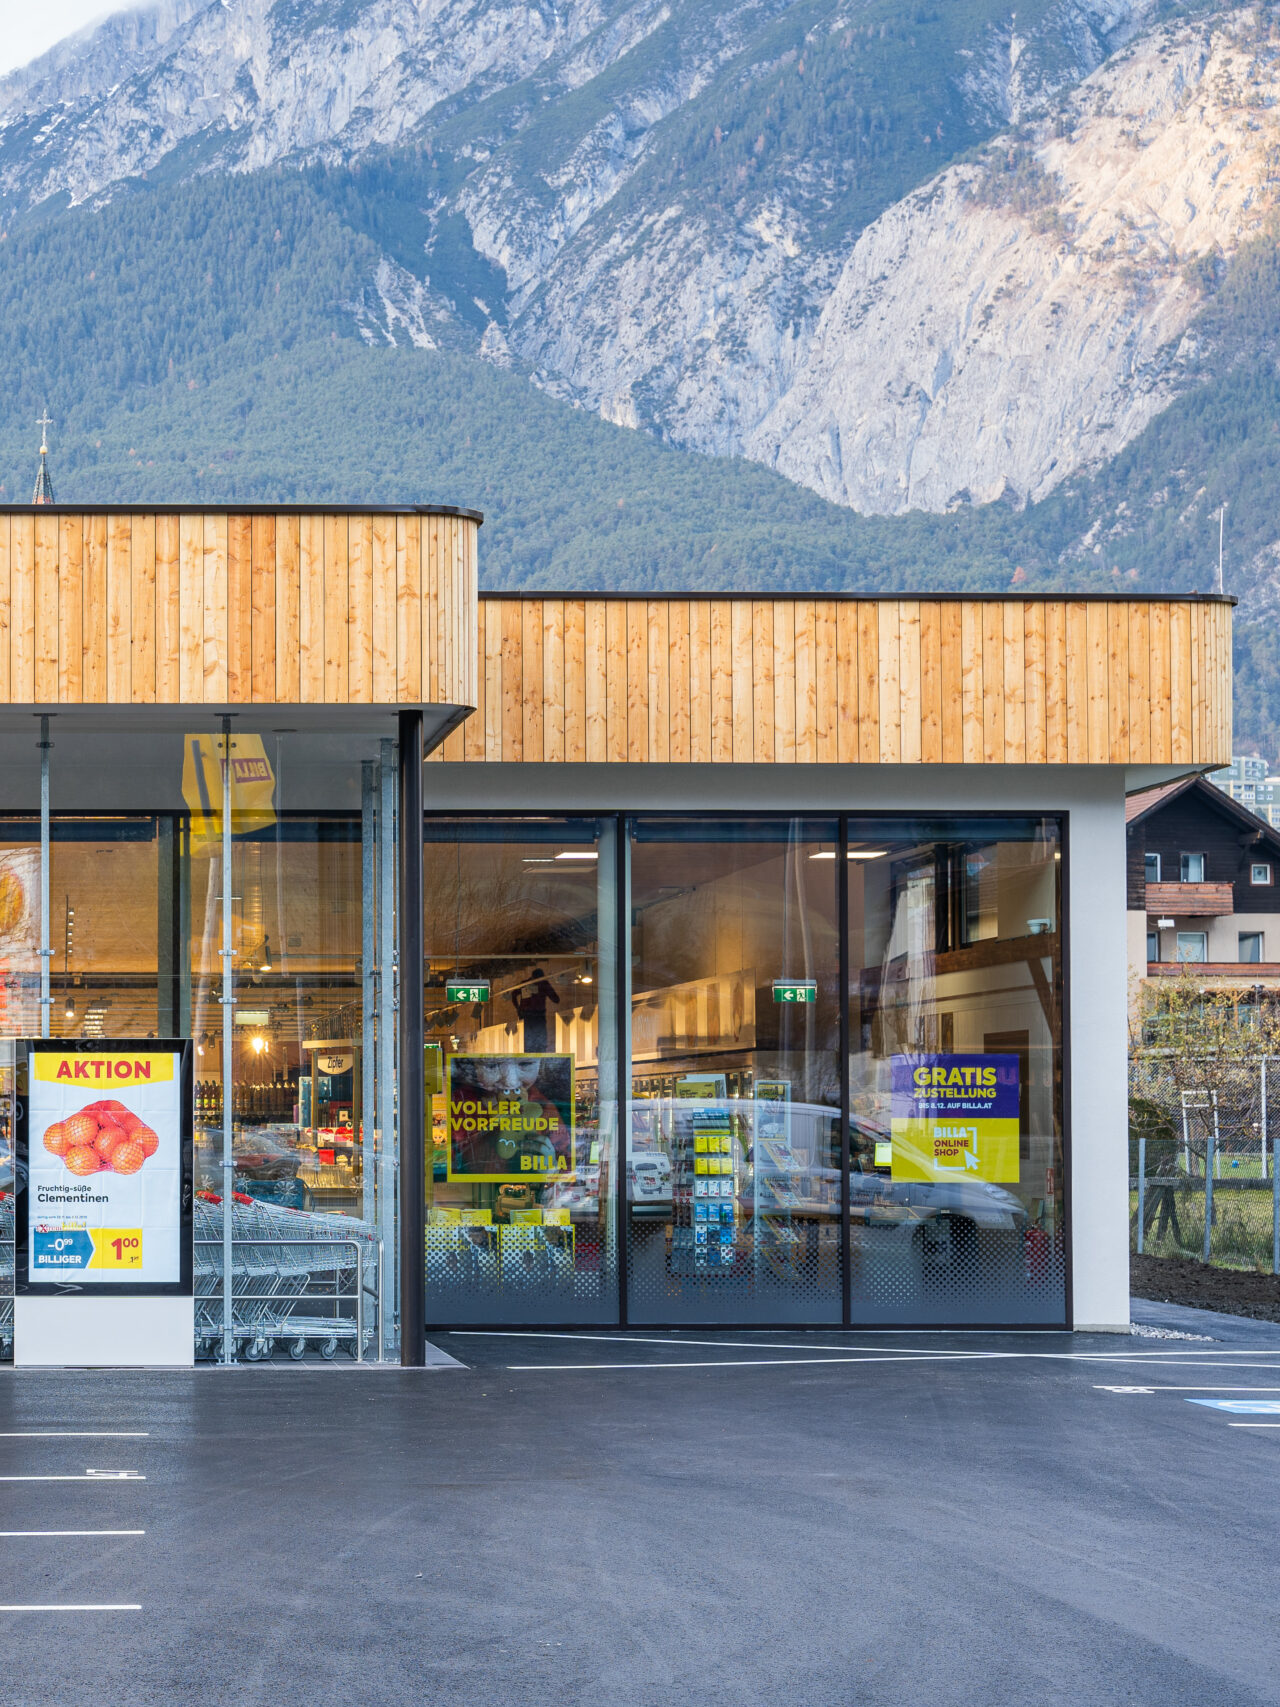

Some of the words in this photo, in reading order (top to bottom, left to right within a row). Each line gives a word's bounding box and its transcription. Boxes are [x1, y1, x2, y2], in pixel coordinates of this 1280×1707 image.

[56, 1061, 151, 1079] AKTION
[328, 1056, 343, 1072] Zipfer
[913, 1067, 997, 1086] GRATIS
[913, 1088, 997, 1098] ZUSTELLUNG
[451, 1101, 520, 1114] VOLLER
[451, 1118, 558, 1131] VORFREUDE
[933, 1127, 968, 1138] BILLA
[520, 1155, 567, 1170] BILLA
[38, 1185, 91, 1193] Fruchtig-süße
[38, 1193, 109, 1202] Clementinen
[38, 1255, 81, 1264] BILLIGER
